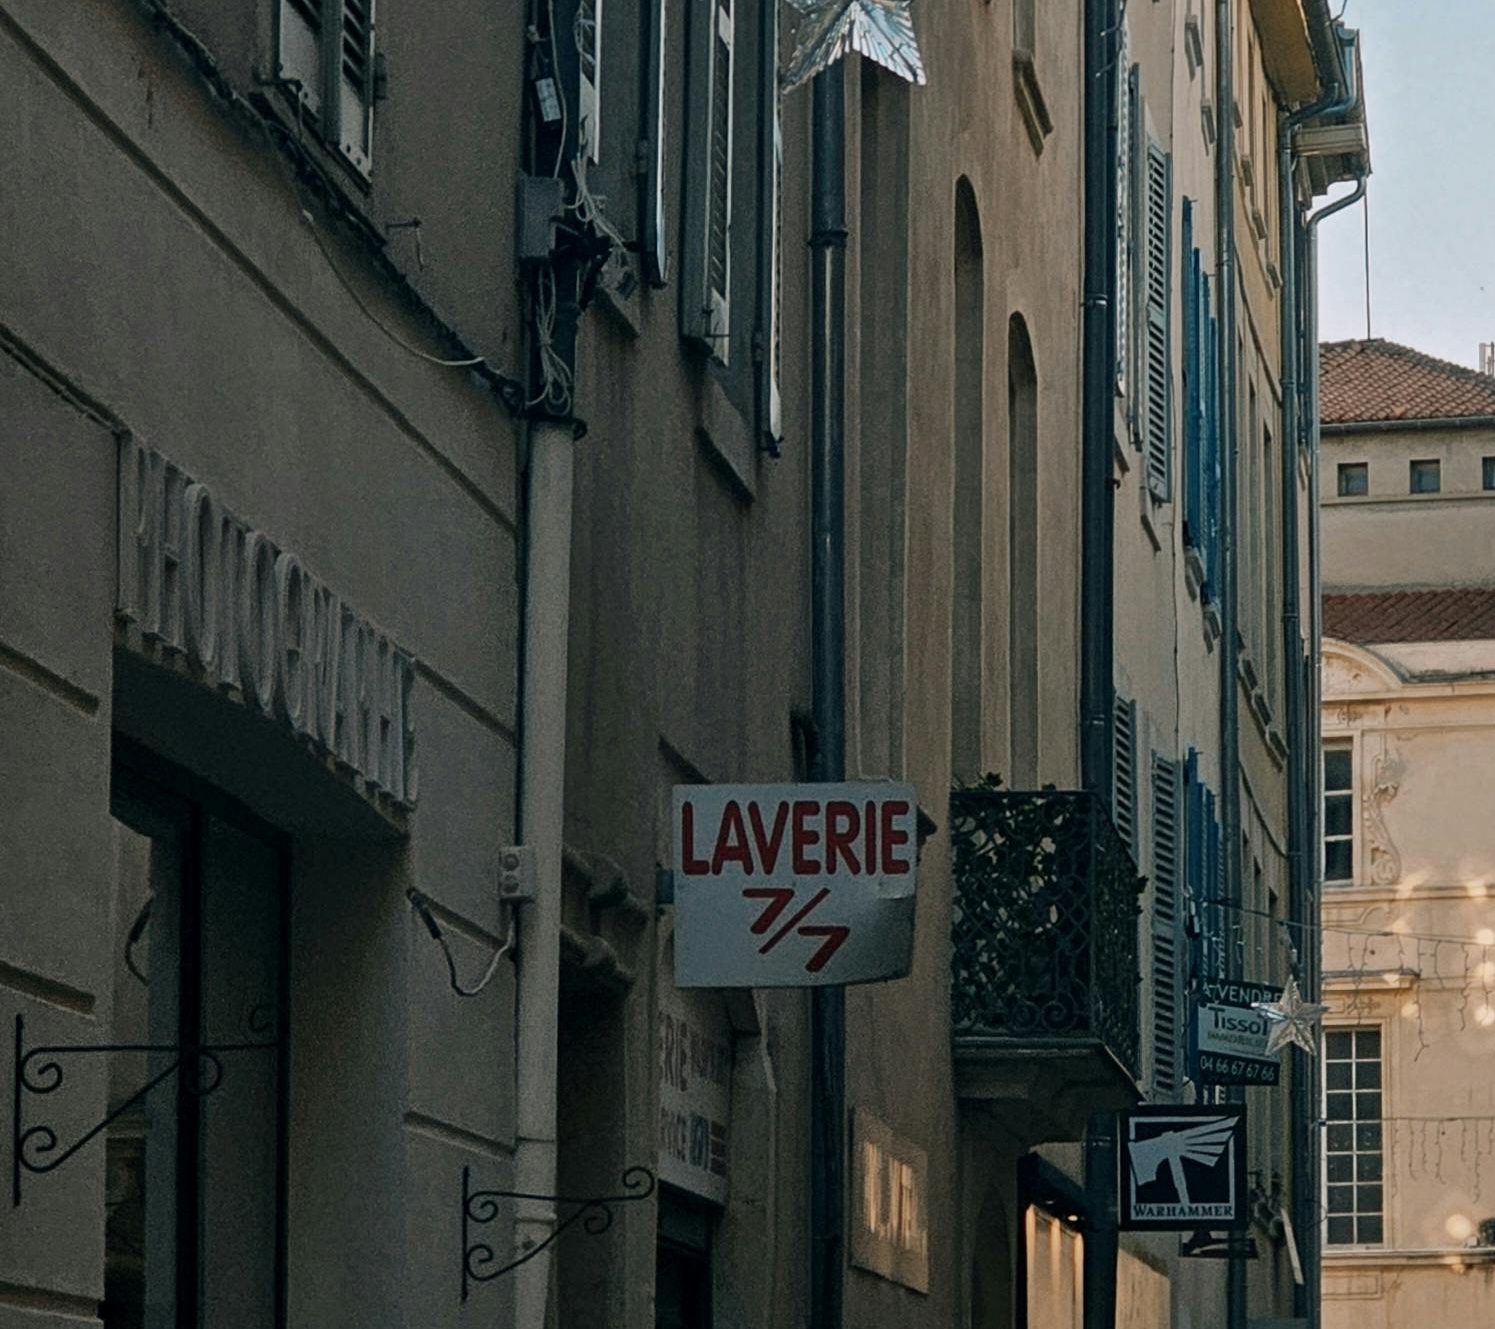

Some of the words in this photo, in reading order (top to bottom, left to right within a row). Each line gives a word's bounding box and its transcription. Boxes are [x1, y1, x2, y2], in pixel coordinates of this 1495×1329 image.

[681, 799, 910, 875] LAVERIE
[742, 887, 849, 972] 7/7
[1218, 984, 1282, 1004] VENDRE
[1200, 1055, 1213, 1071] 04
[1215, 1058, 1229, 1074] 66
[1231, 1060, 1246, 1075] 67
[1246, 1063, 1260, 1078] 67
[1261, 1066, 1275, 1081] 66
